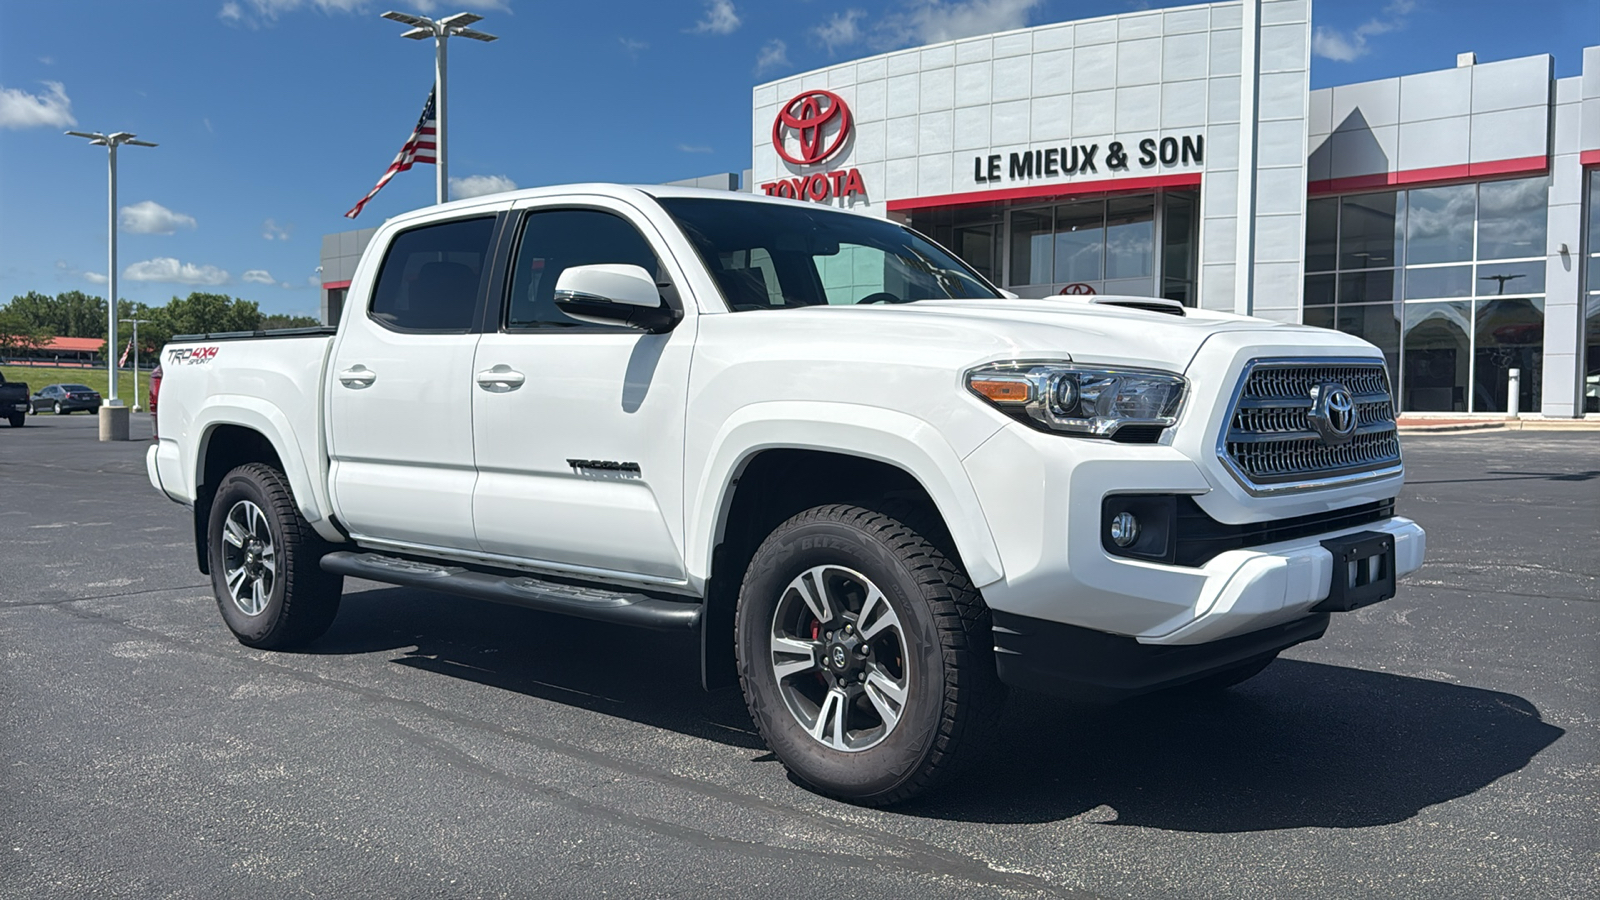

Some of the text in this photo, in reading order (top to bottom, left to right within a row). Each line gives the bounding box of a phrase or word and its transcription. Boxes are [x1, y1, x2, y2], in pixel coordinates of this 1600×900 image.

[975, 134, 1204, 182] LE MIEUX & SON
[761, 168, 865, 201] TOYOTA
[168, 348, 193, 365] TRD
[187, 358, 212, 366] SPORT
